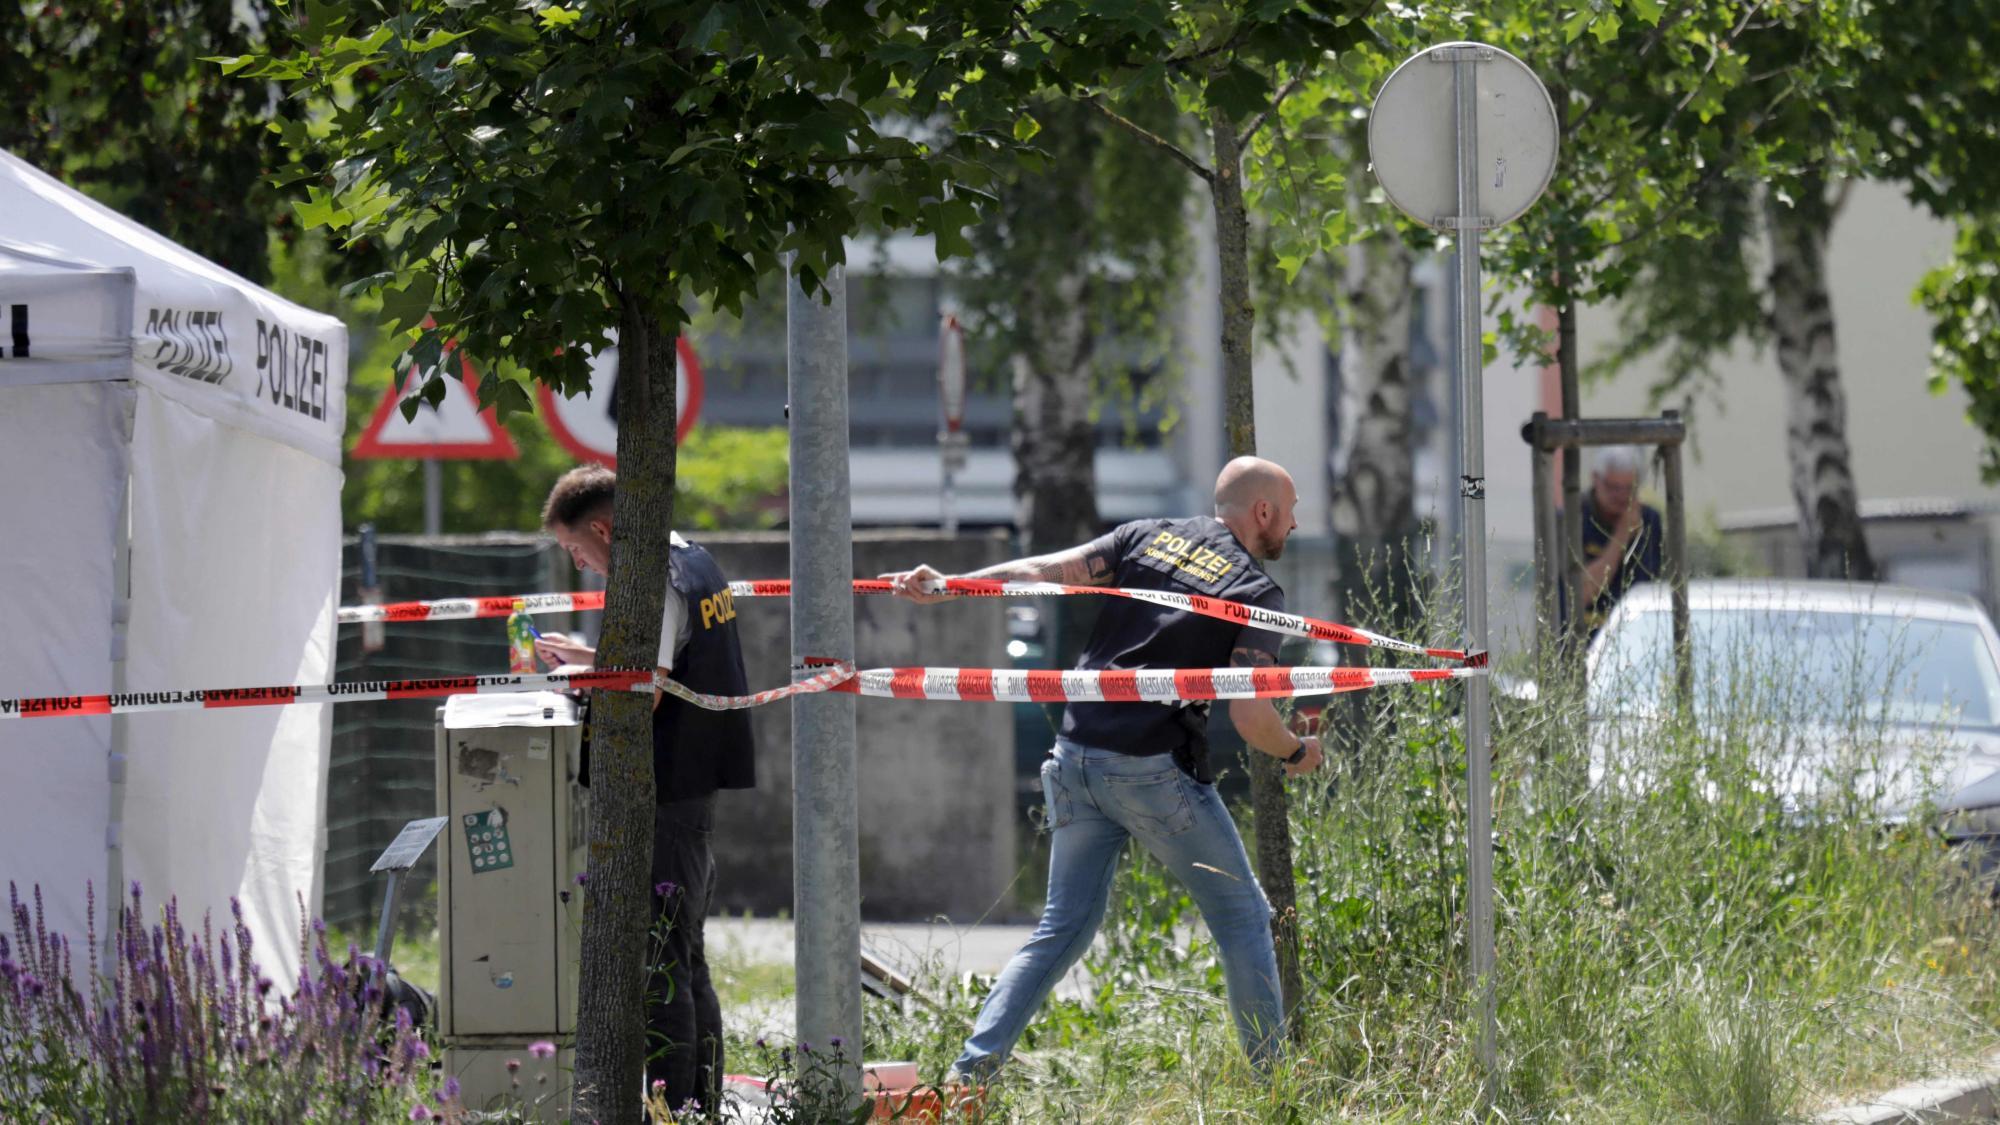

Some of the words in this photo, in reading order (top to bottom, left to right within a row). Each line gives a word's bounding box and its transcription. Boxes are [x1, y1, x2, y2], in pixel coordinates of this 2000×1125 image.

[256, 319, 328, 421] POLIZEI
[1144, 546, 1219, 584] KRIMINALDIENST
[1152, 531, 1233, 575] POLIZEI
